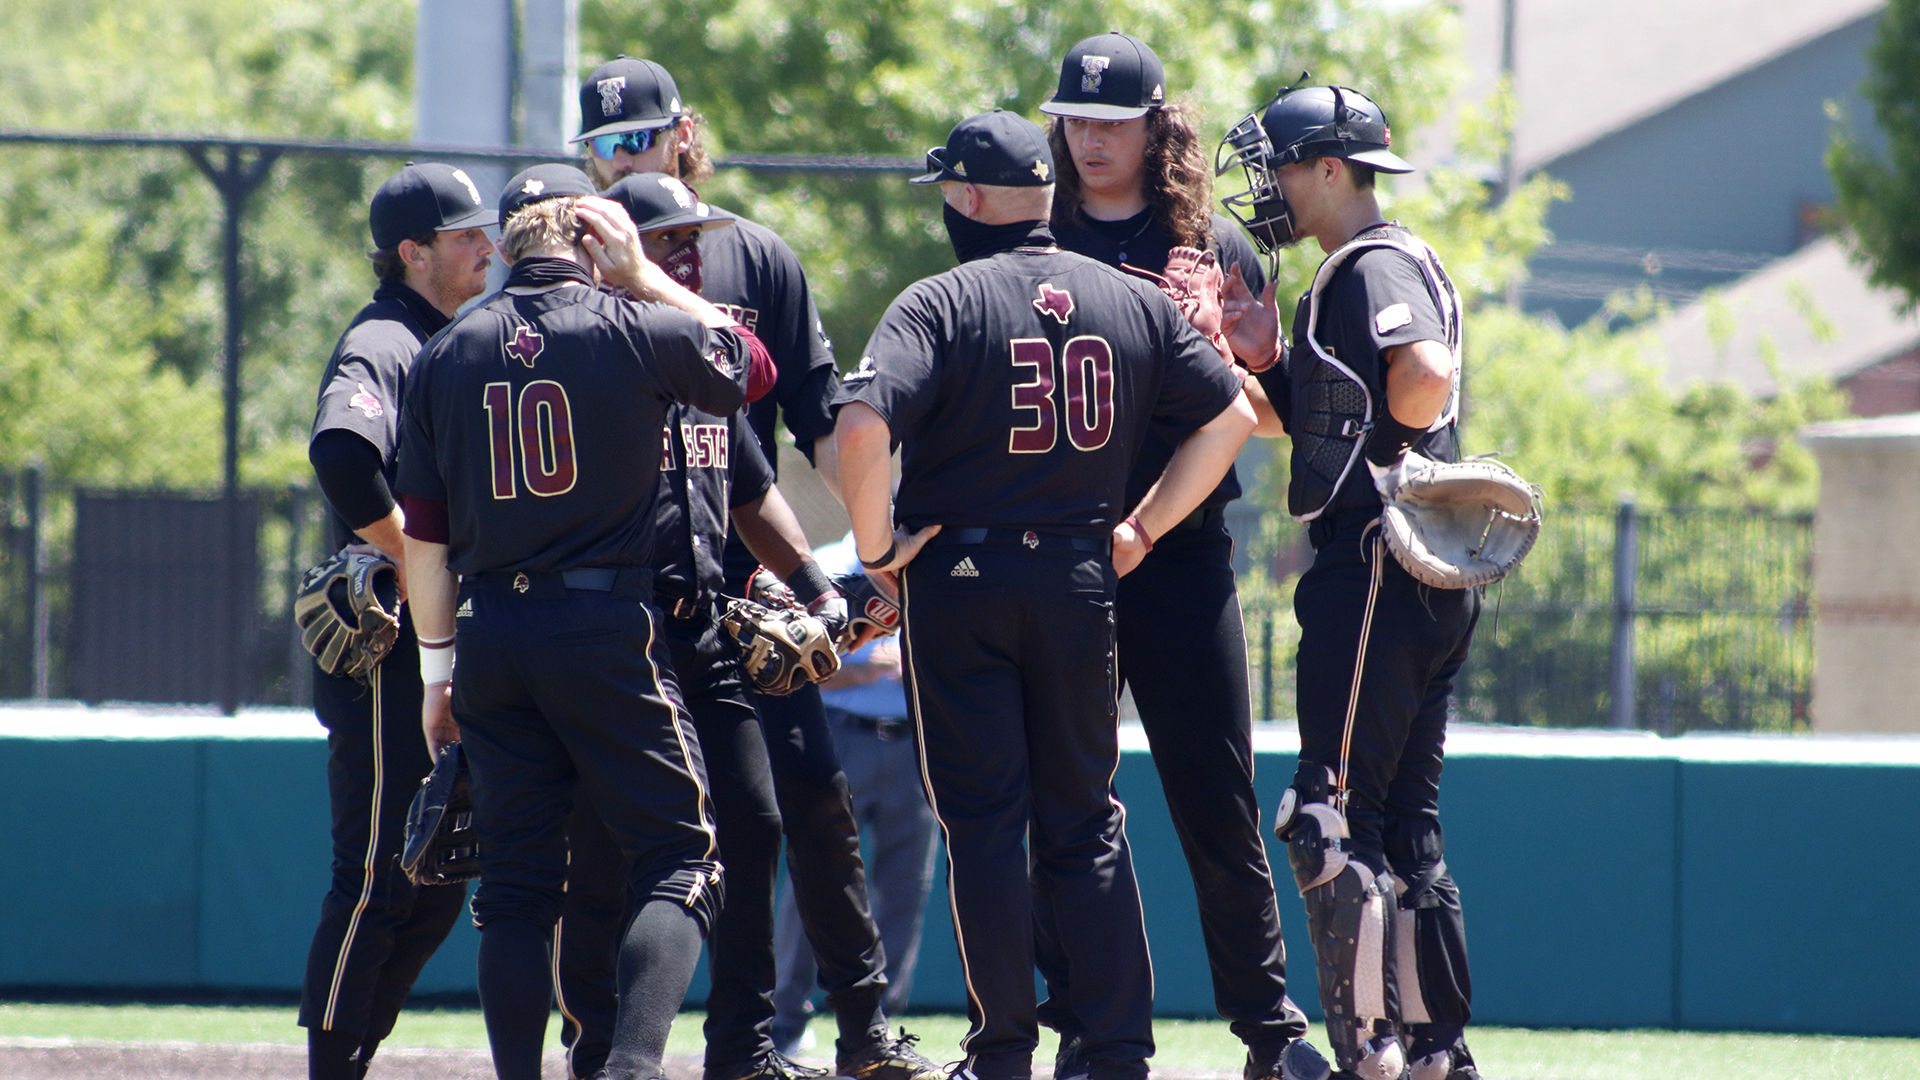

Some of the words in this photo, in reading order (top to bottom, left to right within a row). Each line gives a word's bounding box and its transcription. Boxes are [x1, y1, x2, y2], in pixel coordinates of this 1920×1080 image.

[483, 379, 577, 499] 10
[1009, 335, 1114, 453] 30
[950, 569, 979, 577] adidas
